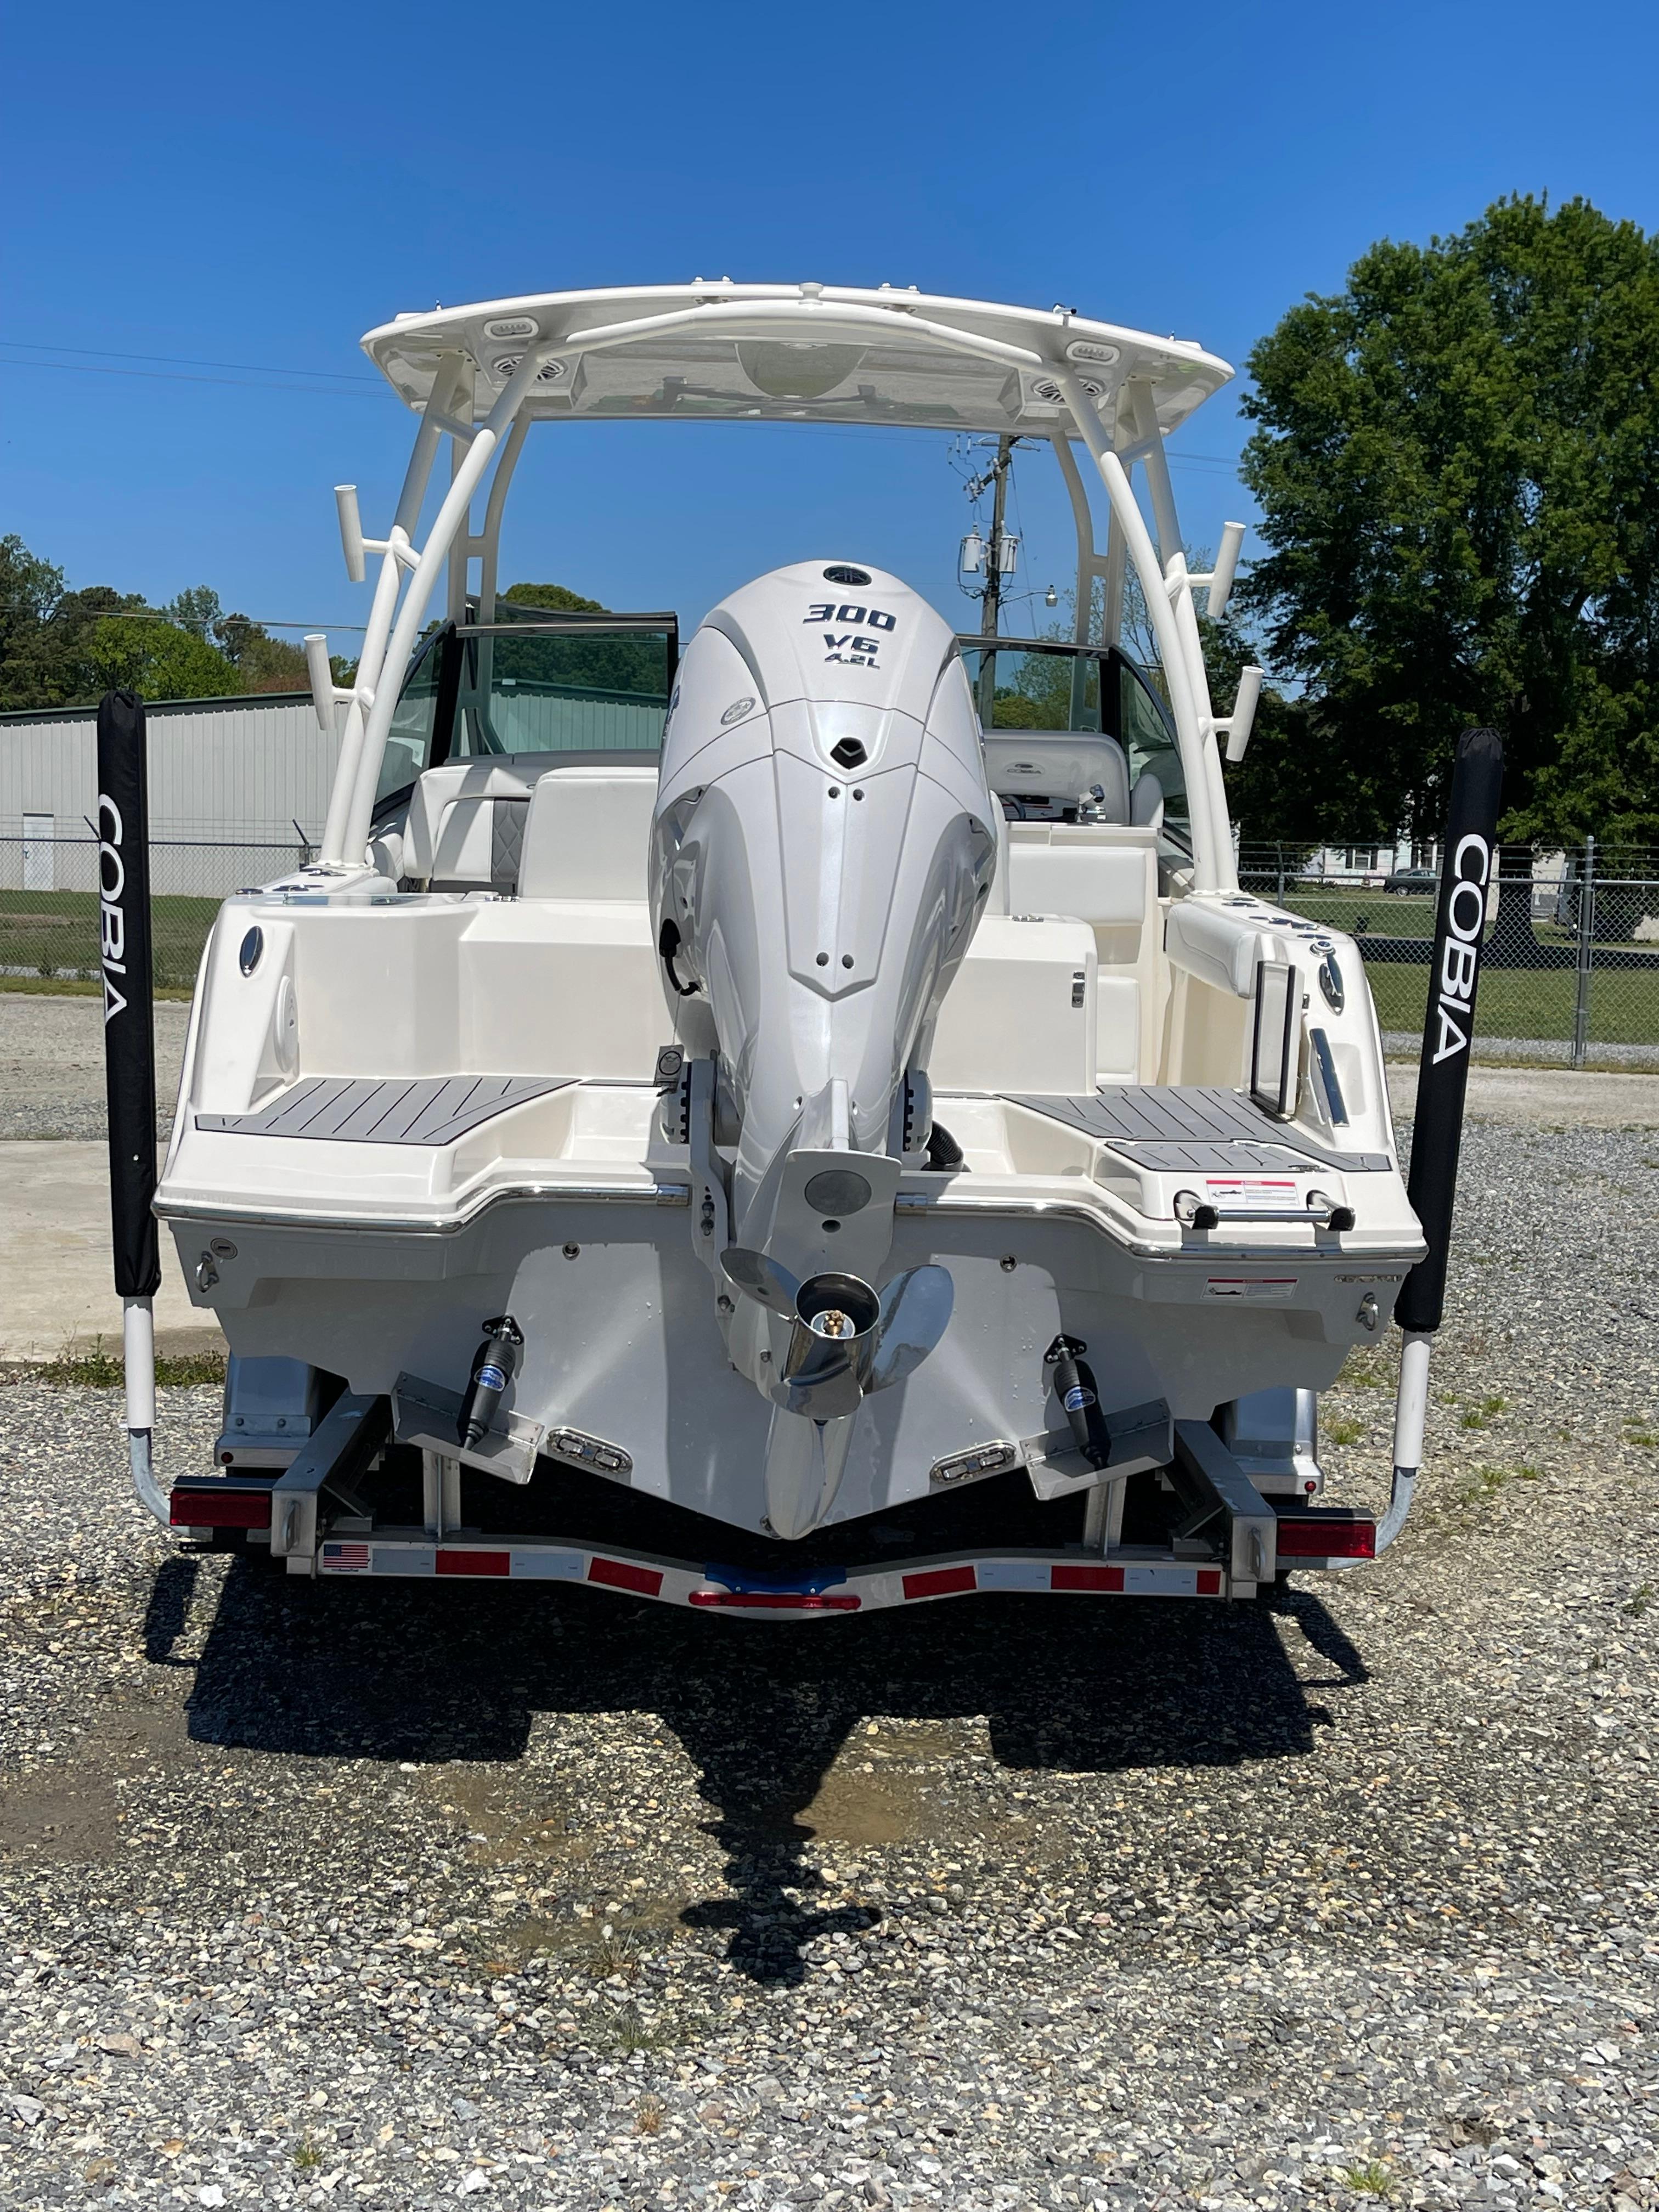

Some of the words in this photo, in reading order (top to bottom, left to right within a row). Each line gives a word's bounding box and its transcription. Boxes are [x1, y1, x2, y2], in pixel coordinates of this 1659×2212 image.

[803, 603, 896, 633] 300
[823, 634, 880, 654] V6
[825, 653, 880, 669] 4.2L
[99, 793, 127, 1026] COBIA
[1432, 833, 1489, 1065] COBIA
